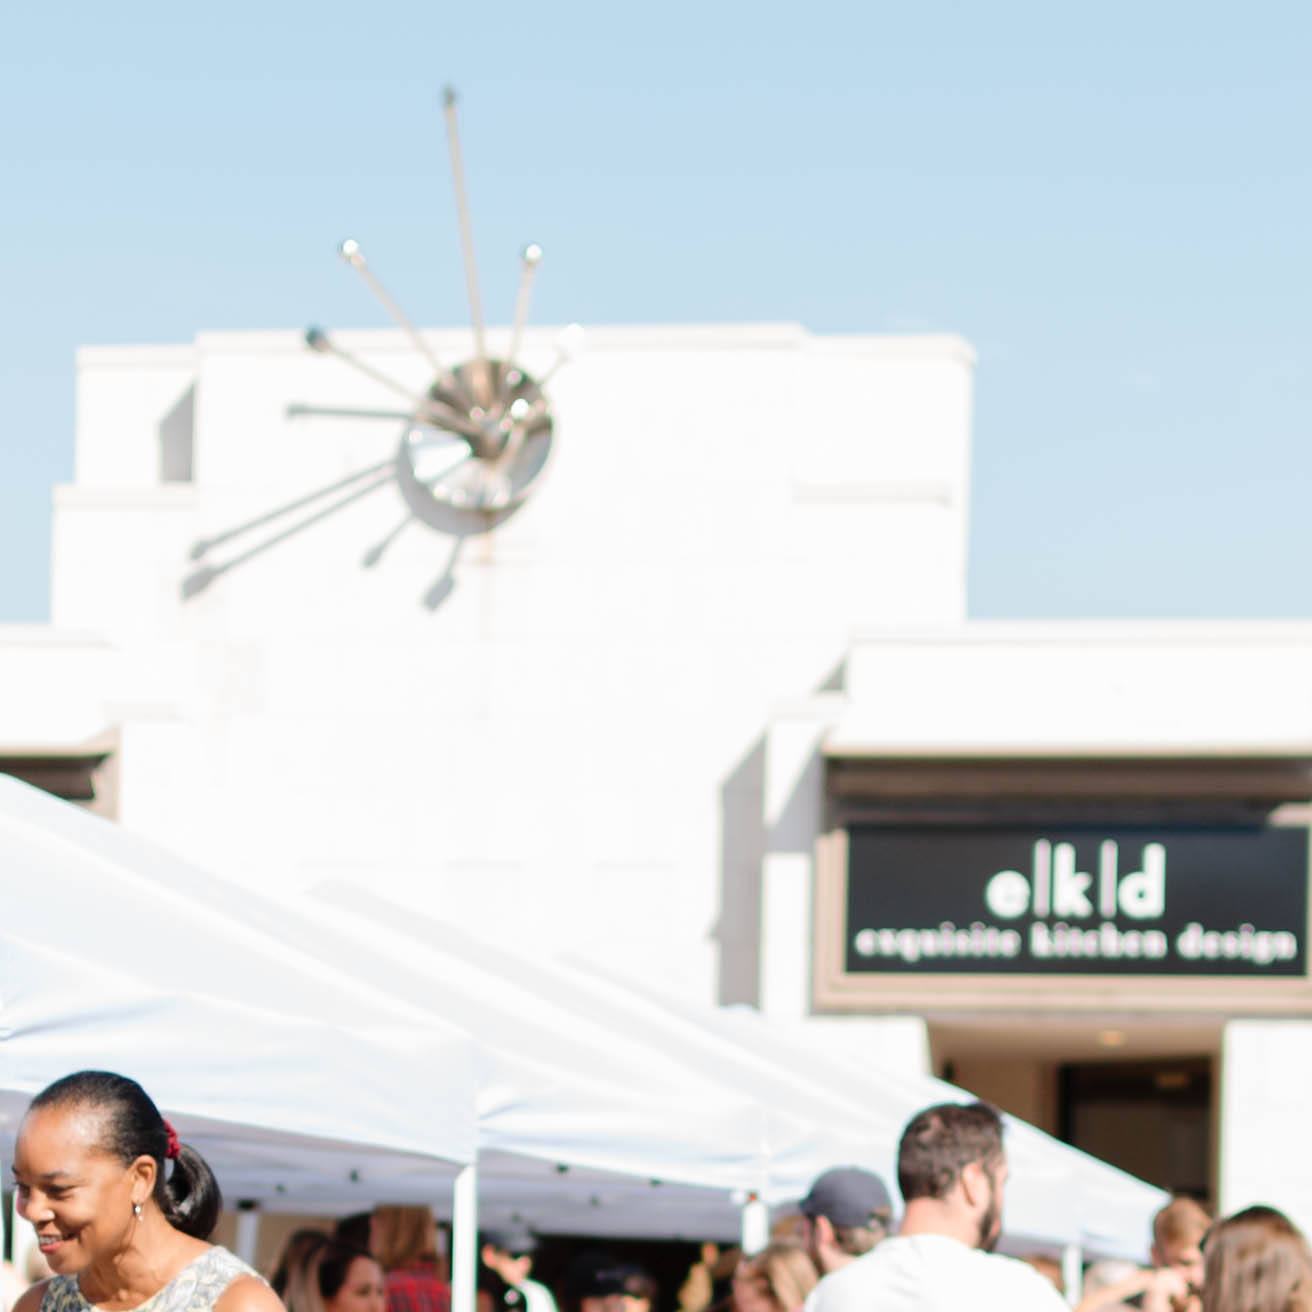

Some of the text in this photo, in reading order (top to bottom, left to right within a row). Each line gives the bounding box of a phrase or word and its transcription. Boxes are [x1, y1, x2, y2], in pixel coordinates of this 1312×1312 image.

[855, 921, 1297, 965] exquisite kitchen design
